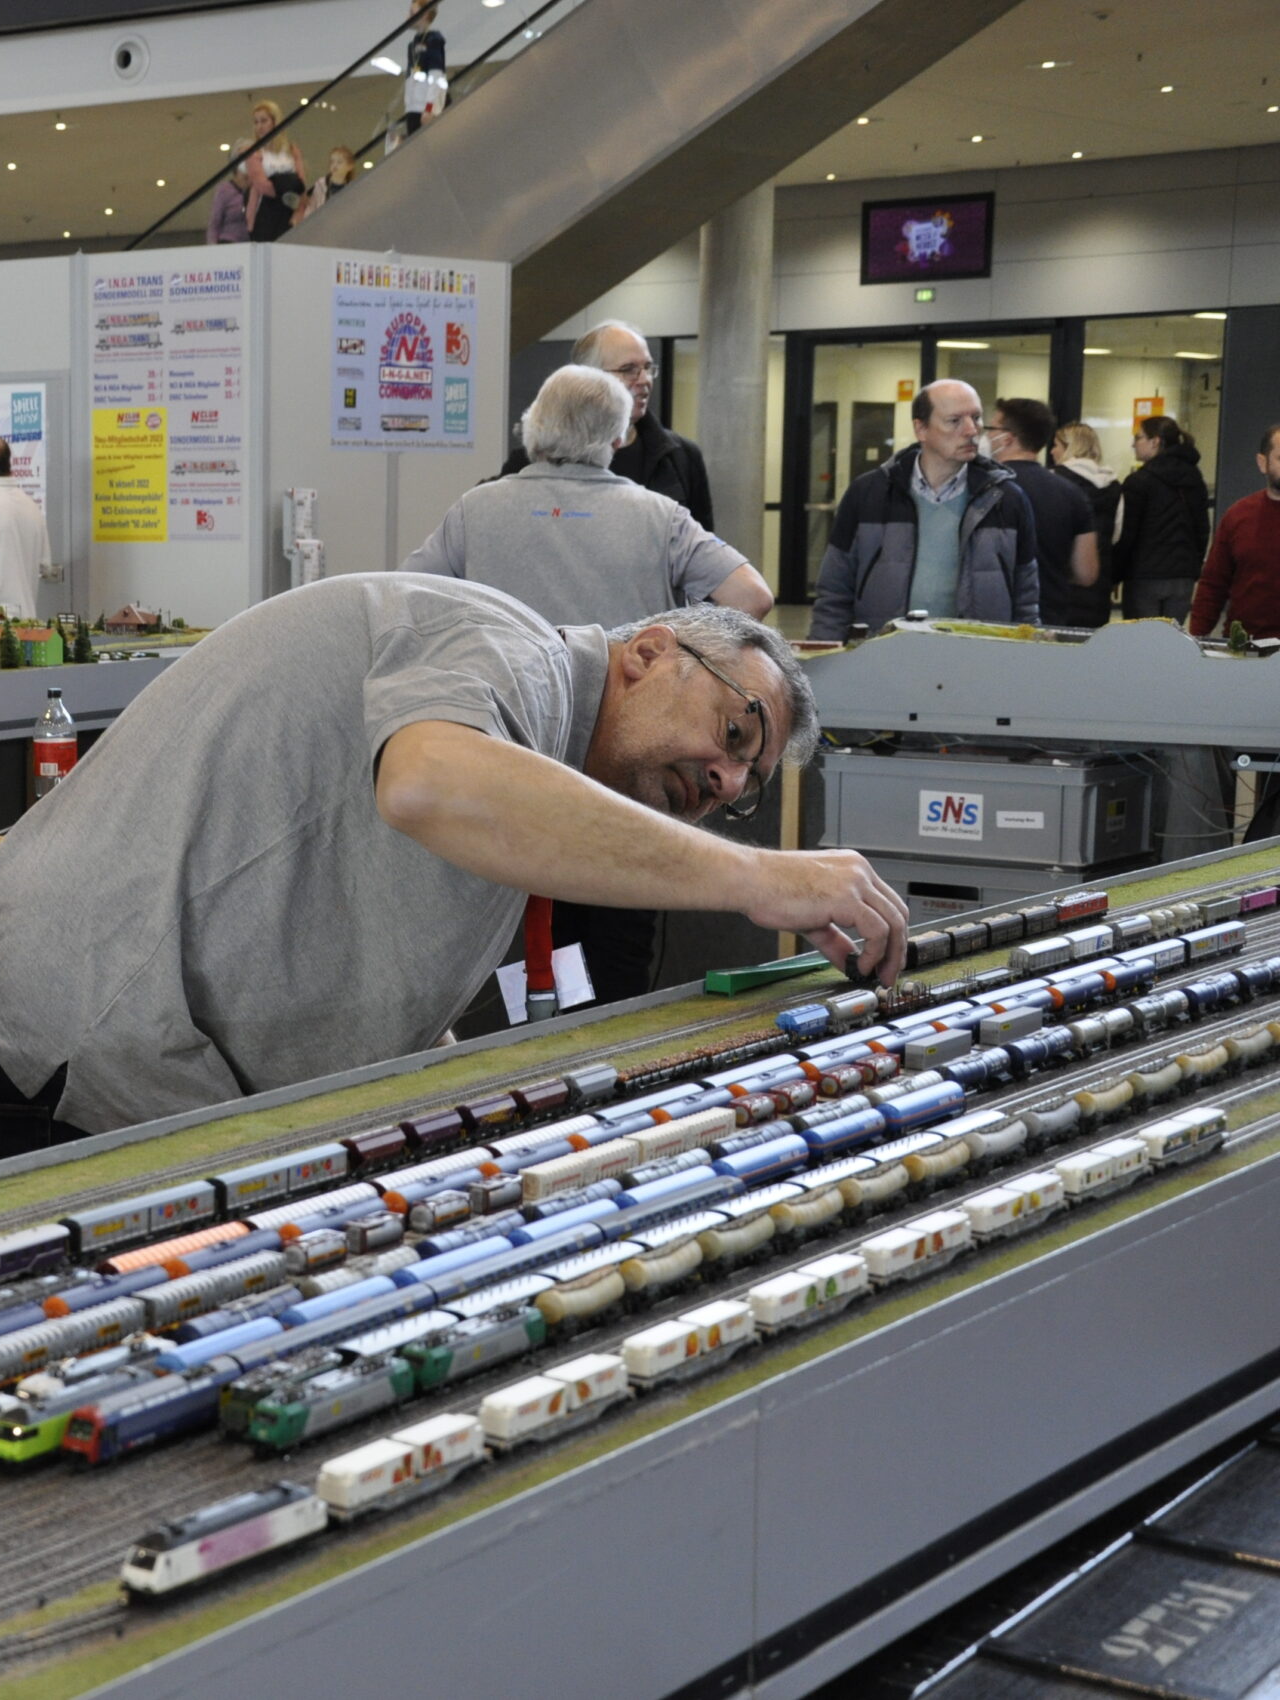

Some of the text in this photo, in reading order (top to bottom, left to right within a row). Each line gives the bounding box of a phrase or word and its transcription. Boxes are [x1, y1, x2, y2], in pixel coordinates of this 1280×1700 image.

[137, 275, 163, 286] TRANS
[214, 270, 241, 281] TRANS
[94, 290, 147, 301] SONDERMODELL
[169, 284, 240, 296] SONDERMODELL
[395, 336, 419, 362] N
[200, 410, 218, 418] CLUB
[169, 435, 216, 444] SONDERMODELL
